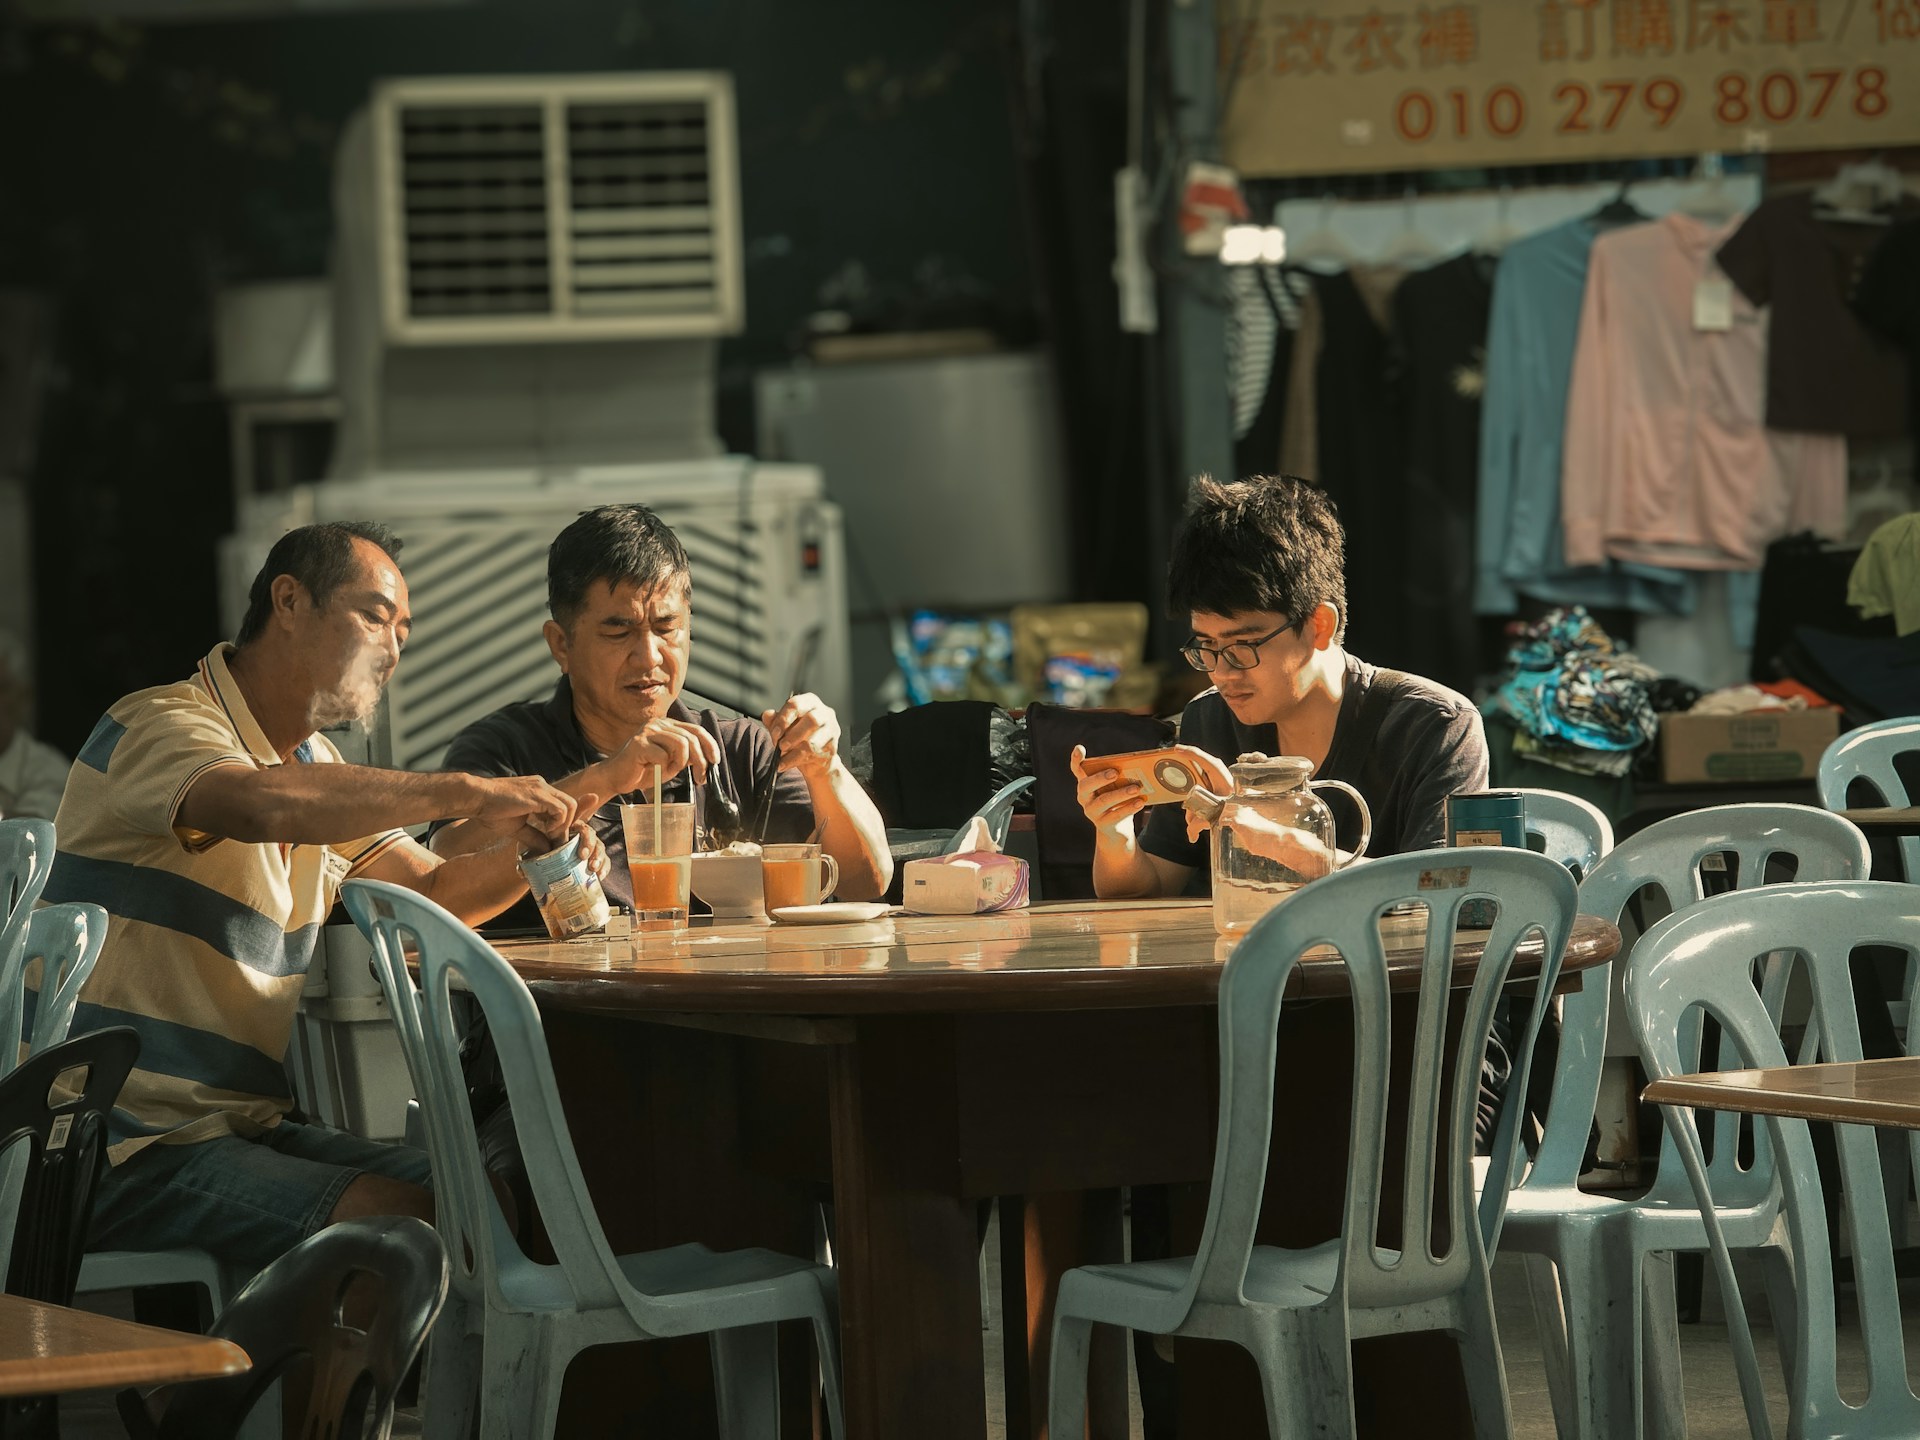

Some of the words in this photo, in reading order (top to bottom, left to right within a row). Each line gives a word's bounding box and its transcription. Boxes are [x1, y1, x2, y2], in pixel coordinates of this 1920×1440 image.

[1396, 86, 1527, 142] 010
[1554, 78, 1685, 135] 279
[1714, 66, 1890, 126] 8078
